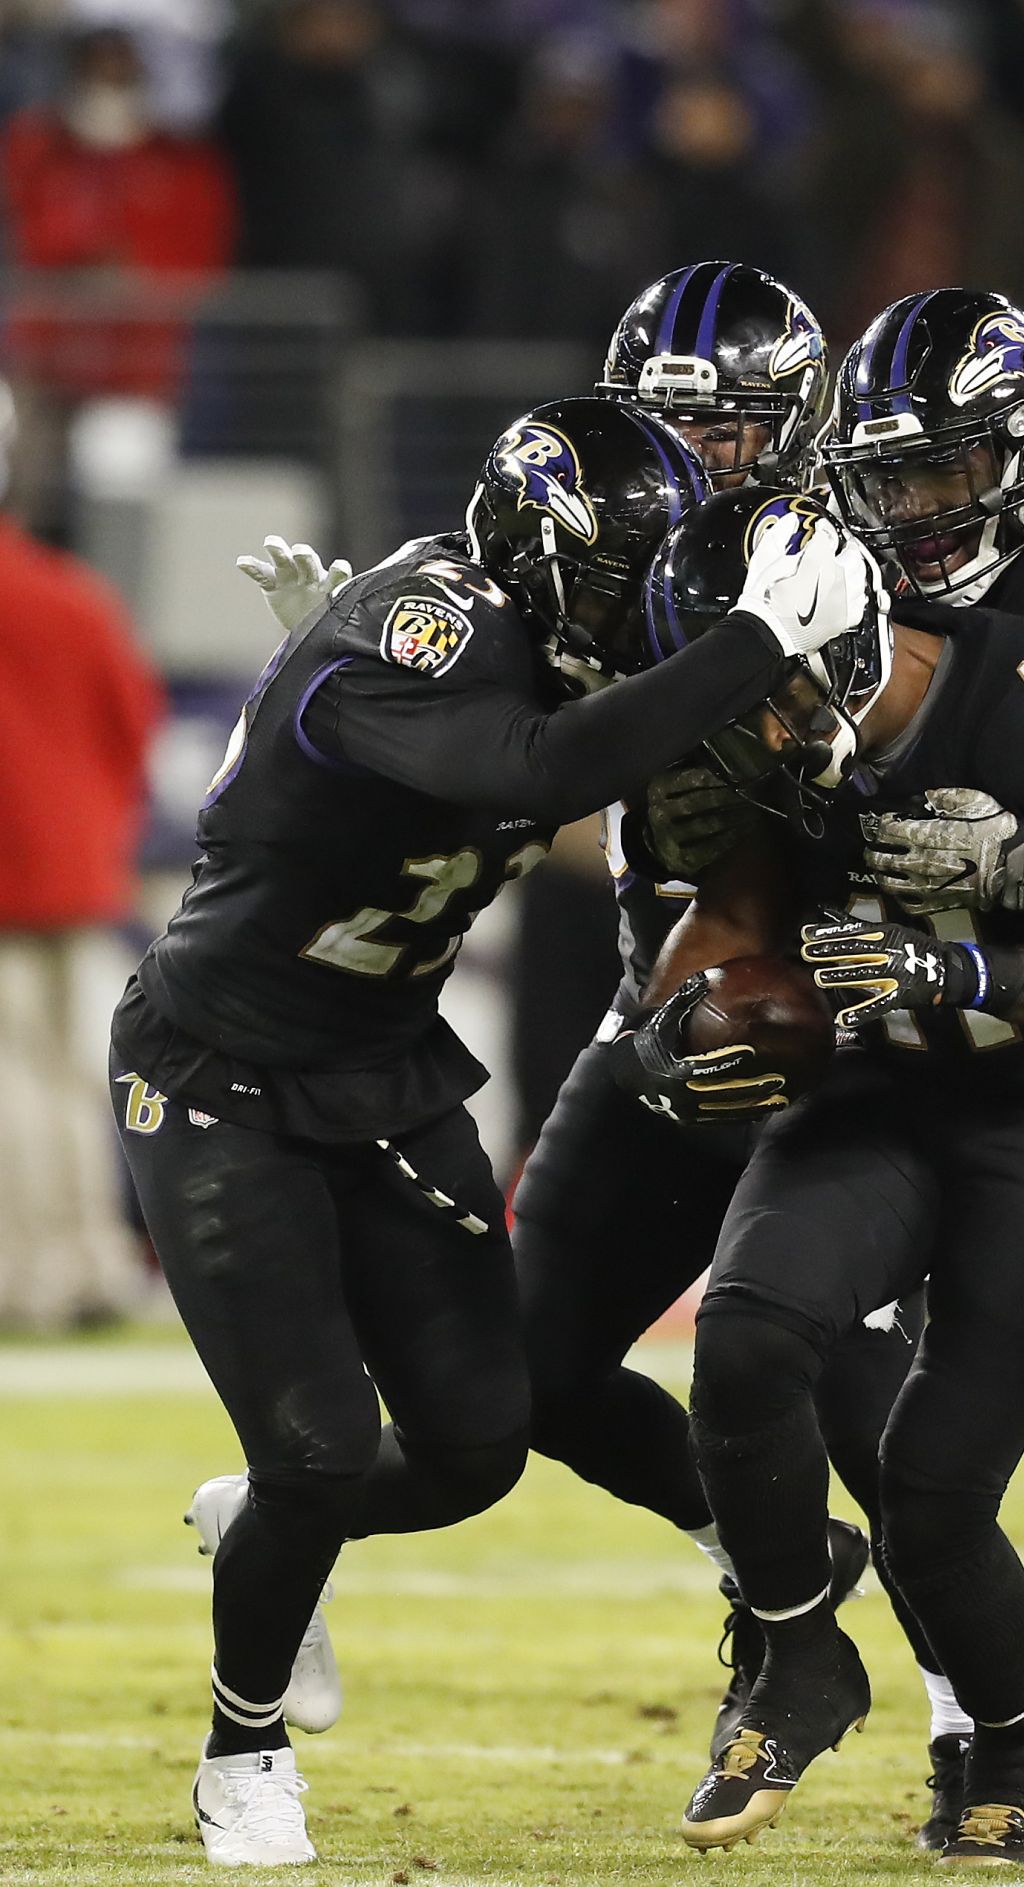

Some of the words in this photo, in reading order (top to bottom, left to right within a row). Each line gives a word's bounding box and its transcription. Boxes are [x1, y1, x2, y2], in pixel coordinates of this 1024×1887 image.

[740, 380, 771, 390] RAVENS
[403, 601, 465, 631] RAVENS
[691, 1056, 744, 1077] SPOTLIGHT
